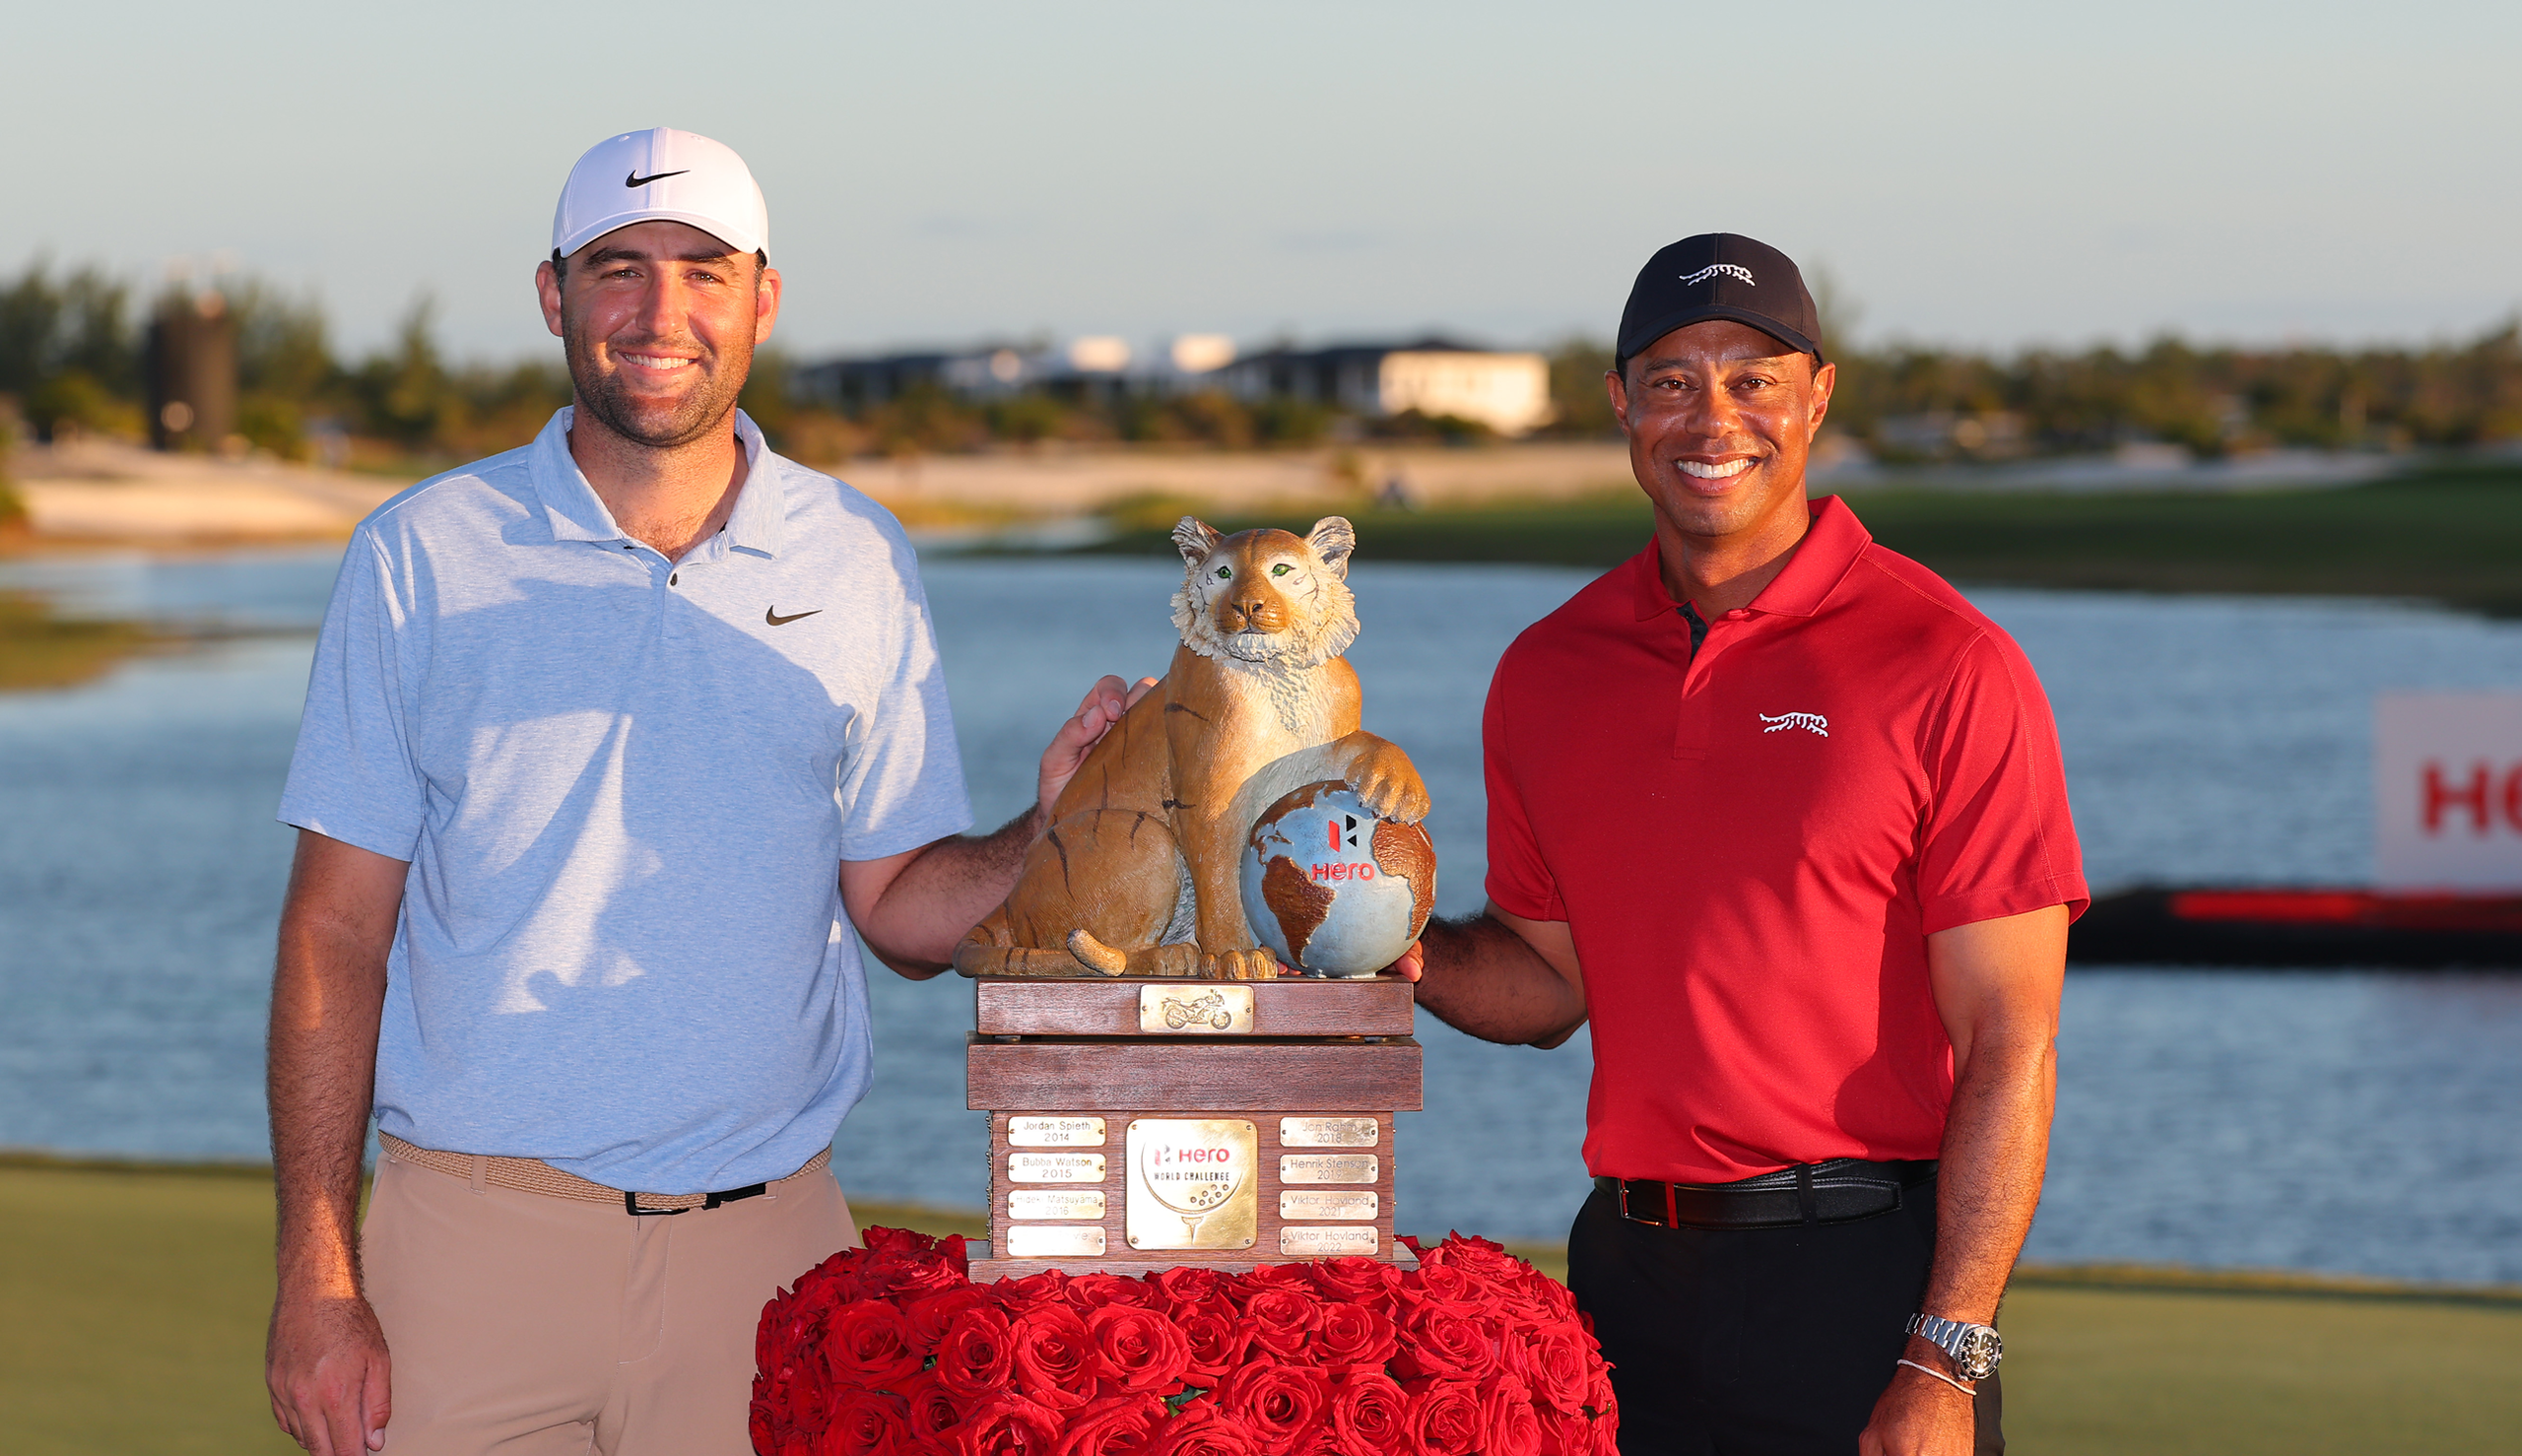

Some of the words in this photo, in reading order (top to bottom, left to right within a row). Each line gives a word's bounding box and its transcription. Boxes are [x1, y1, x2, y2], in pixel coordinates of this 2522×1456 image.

[2420, 758, 2522, 838] H
[1311, 862, 1375, 881] Hero
[1024, 1121, 1055, 1131] Jordan
[1059, 1121, 1091, 1132] Spieth
[1302, 1122, 1322, 1132] Jon
[1044, 1133, 1070, 1143] 2014
[1317, 1134, 1342, 1144] 2018
[1179, 1148, 1229, 1162] Hero
[1023, 1158, 1052, 1166] Bubba
[1055, 1158, 1093, 1166] Watson
[1291, 1158, 1323, 1168] Henrik
[1326, 1158, 1368, 1168] Stenson
[1042, 1169, 1072, 1178] 2015
[1155, 1172, 1180, 1181] WORLD
[1184, 1172, 1230, 1181] CHALLENGE
[1317, 1170, 1342, 1179] 2019
[1047, 1195, 1098, 1205] Matsuyama
[1291, 1195, 1319, 1205] Viktor
[1325, 1195, 1369, 1205] Hovland
[1045, 1207, 1069, 1216] 2016
[1291, 1231, 1319, 1241] Viktor
[1325, 1231, 1369, 1241] Hovland
[1317, 1243, 1342, 1252] 2022
